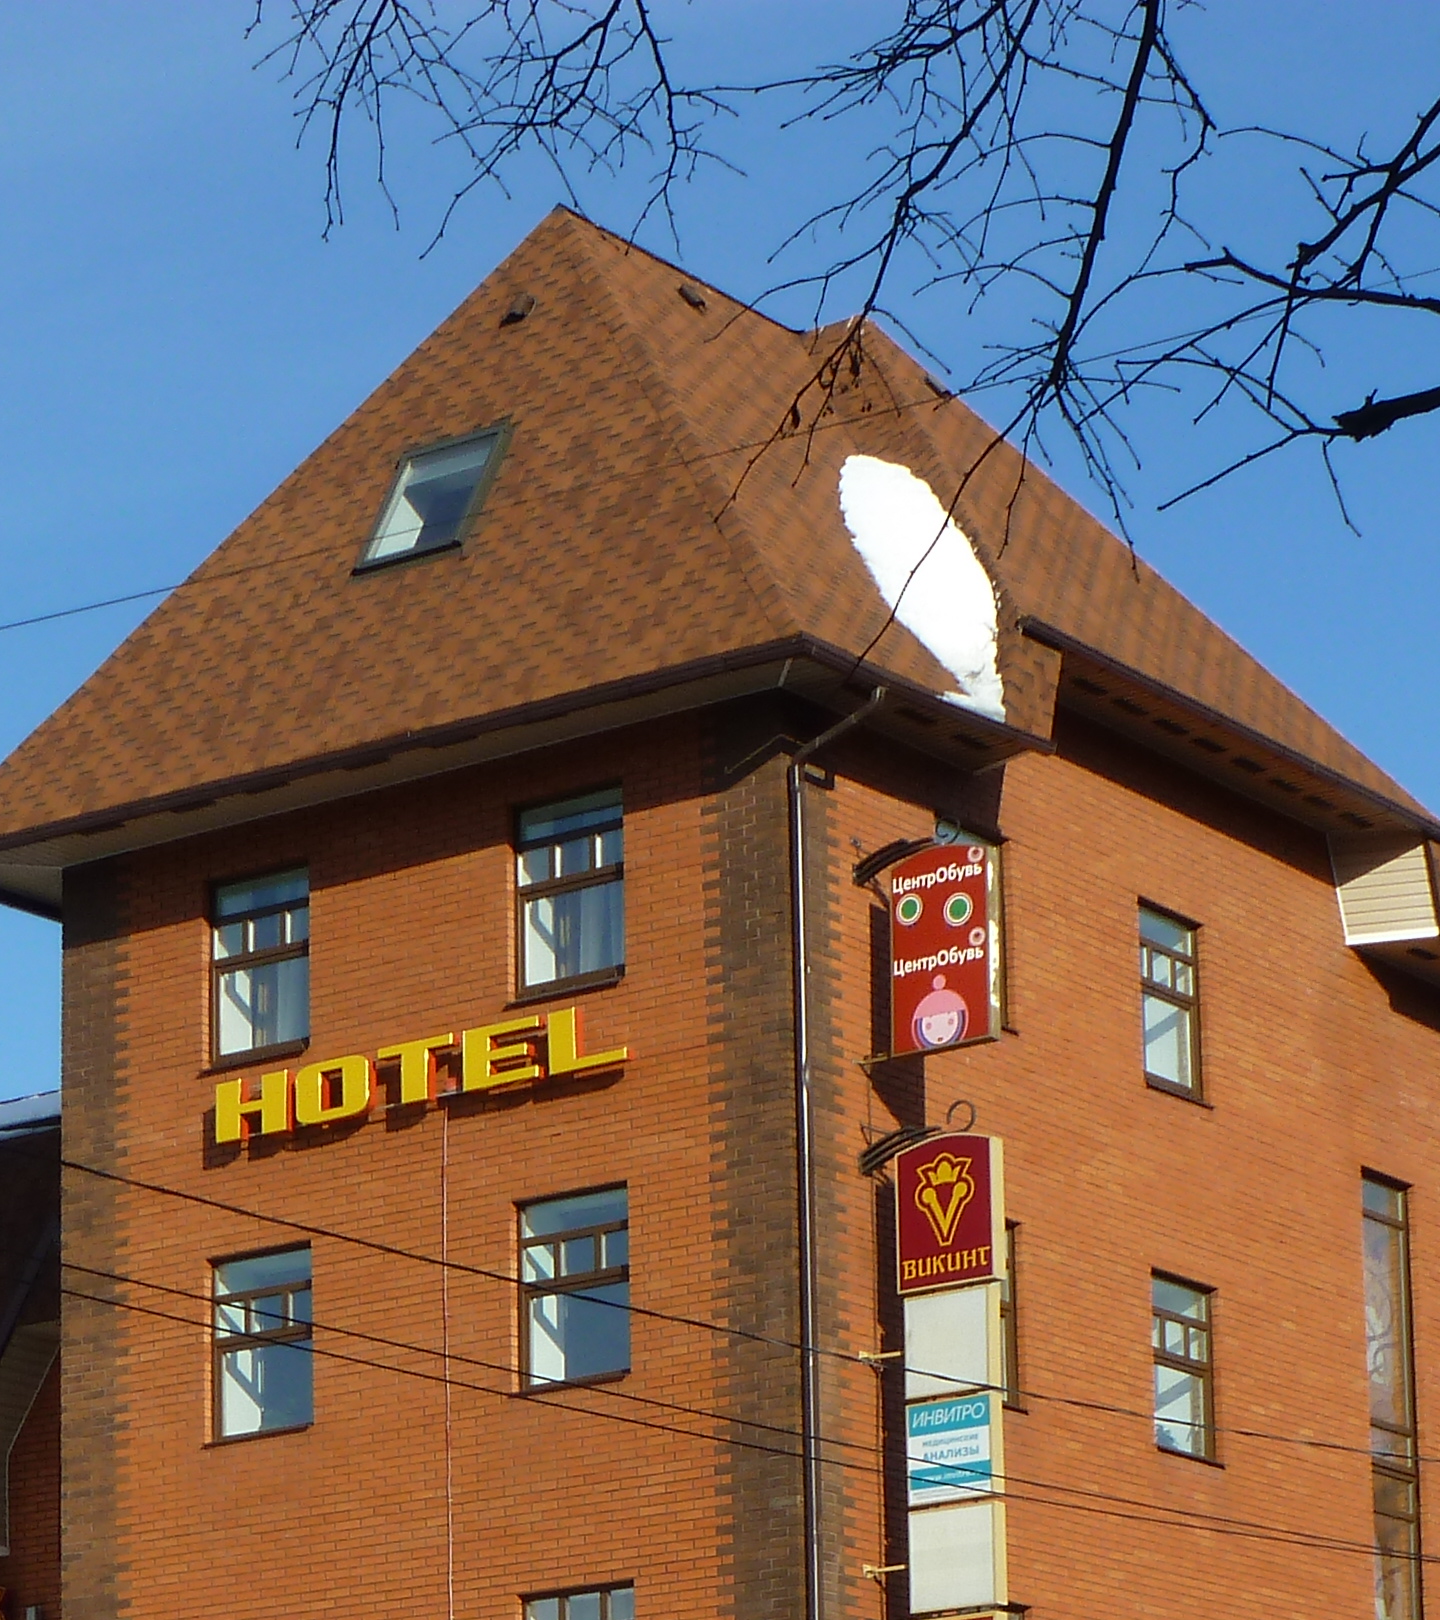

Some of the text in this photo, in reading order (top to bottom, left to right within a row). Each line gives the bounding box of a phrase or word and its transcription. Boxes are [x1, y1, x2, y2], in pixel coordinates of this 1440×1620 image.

[892, 863, 982, 894] ЦентрОбувь
[893, 946, 984, 977] ЦентрОбувь
[215, 1007, 630, 1144] HOTEL
[912, 1402, 985, 1428] ИНВИТРО
[923, 1445, 979, 1461] АНАЛИЗЫ
